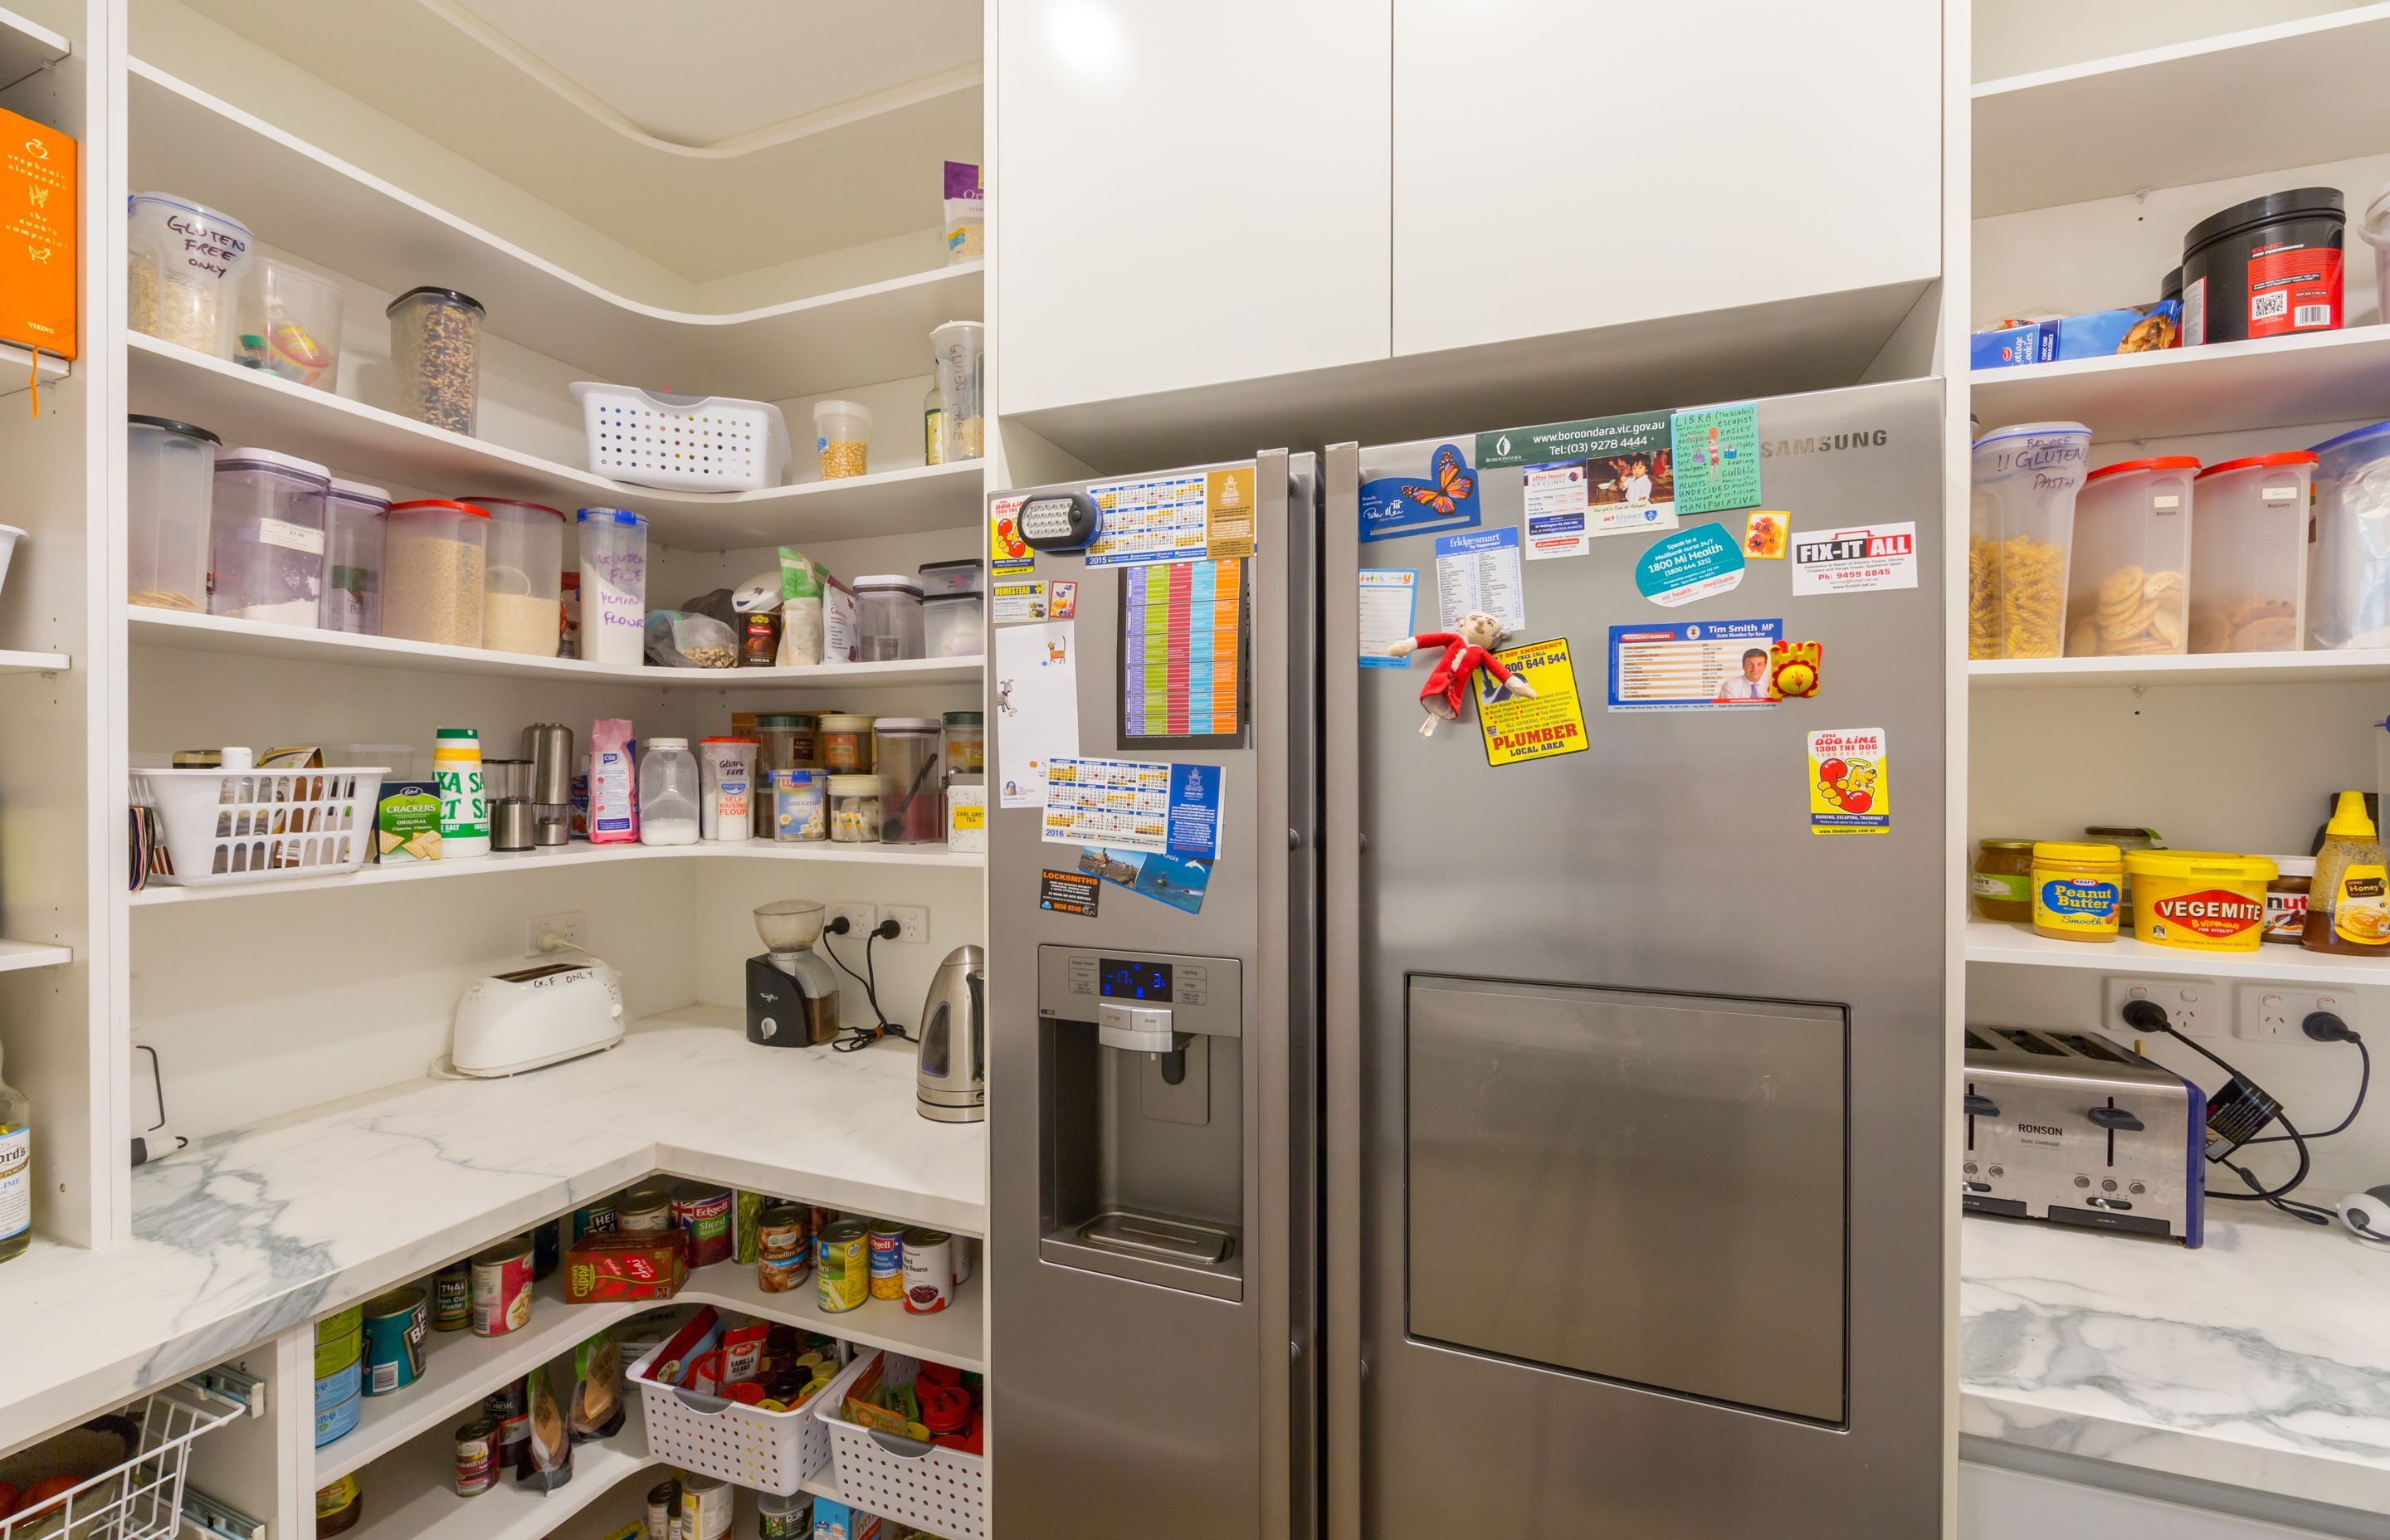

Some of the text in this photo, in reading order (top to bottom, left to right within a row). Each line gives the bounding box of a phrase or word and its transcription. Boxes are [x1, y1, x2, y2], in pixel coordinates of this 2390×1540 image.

[7, 154, 66, 180] stephanie
[7, 163, 66, 190] alexander
[30, 212, 47, 223] the
[19, 217, 57, 236] cook's
[167, 215, 245, 251] GLUTEN
[184, 239, 237, 261] FREE
[2251, 241, 2284, 254] GNC
[2265, 243, 2305, 255] PERFORMANCE
[188, 258, 227, 279] ONLY
[27, 321, 55, 334] VIKING
[1675, 413, 1711, 426] LIBRA
[1718, 416, 1753, 427] escapist
[1533, 421, 1665, 444] www.boroondara.vic.gov.au
[1720, 426, 1752, 436] EASILY
[1590, 436, 1647, 451] 9278 4444
[1720, 433, 1754, 443] influenced
[1760, 429, 1887, 458] SAMSUNG
[1485, 455, 1522, 463] BOROONDARA
[1727, 457, 1754, 466] bearing
[1678, 463, 1707, 474] indulgent
[1722, 466, 1754, 478] Gullible
[1548, 472, 1566, 480] hours
[2033, 473, 2075, 490] PASTA
[1679, 480, 1706, 490] ALWAYS
[1679, 484, 1730, 498] UNDECIDED
[1680, 494, 1713, 504] intolerant
[1724, 488, 1756, 497] criticism
[1680, 495, 1755, 513] MANIPULATIVE
[1363, 507, 1384, 520] Peter
[1450, 534, 1500, 548] fridgesmart
[1475, 540, 1500, 549] Tupperware
[1666, 540, 1685, 551] Speak
[1655, 539, 1714, 562] Medibank nurse 24/7
[1800, 536, 1910, 563] FIX-IT ALL
[1090, 556, 1107, 565] 2015
[1647, 543, 1723, 573] 1800 Mi Health
[1665, 566, 1683, 578] (1800
[1836, 570, 1861, 579] 9459
[1865, 568, 1890, 578] 6845
[1703, 575, 1735, 589] medibank
[994, 586, 1031, 596] HOMESTEAD
[1672, 587, 1692, 598] health
[601, 591, 640, 605] PLAIN
[604, 611, 644, 628] FLOUR
[1728, 624, 1758, 632] Smith
[1761, 623, 1774, 631] MP
[1520, 641, 1563, 655] EMERGENCY
[1526, 651, 1568, 670] 644 544
[1516, 718, 1539, 727] GENERAL
[1540, 713, 1568, 722] PLUMBING
[1492, 723, 1578, 750] PLUMBER
[963, 748, 983, 759] T2
[1510, 740, 1564, 757] LOCAL AREA
[386, 804, 437, 814] CRACKERS
[719, 809, 748, 817] FLOUR
[1046, 829, 1064, 838] 2016
[1042, 871, 1099, 885] LOCKSMITHS
[2055, 885, 2112, 899] Peanut
[2349, 885, 2379, 893] Honey
[2057, 895, 2110, 909] Butter
[2266, 895, 2308, 910] nut
[2160, 900, 2262, 922] VEGEMITE
[2061, 915, 2103, 926] Smooth
[2191, 919, 2200, 928] B
[566, 970, 593, 983] ONLY
[2018, 1123, 2063, 1136] RONSON
[4, 1164, 25, 1177] PURITY
[696, 1201, 728, 1216] Edgell
[699, 1217, 726, 1231] Sliced
[699, 1225, 726, 1236] Beetroot
[764, 1248, 796, 1260] Cannellini
[910, 1265, 929, 1274] Beans
[441, 1302, 462, 1310] Paste
[730, 1357, 754, 1368] VANILLA
[732, 1364, 751, 1375] BEANS
[786, 1510, 804, 1522] Dole
